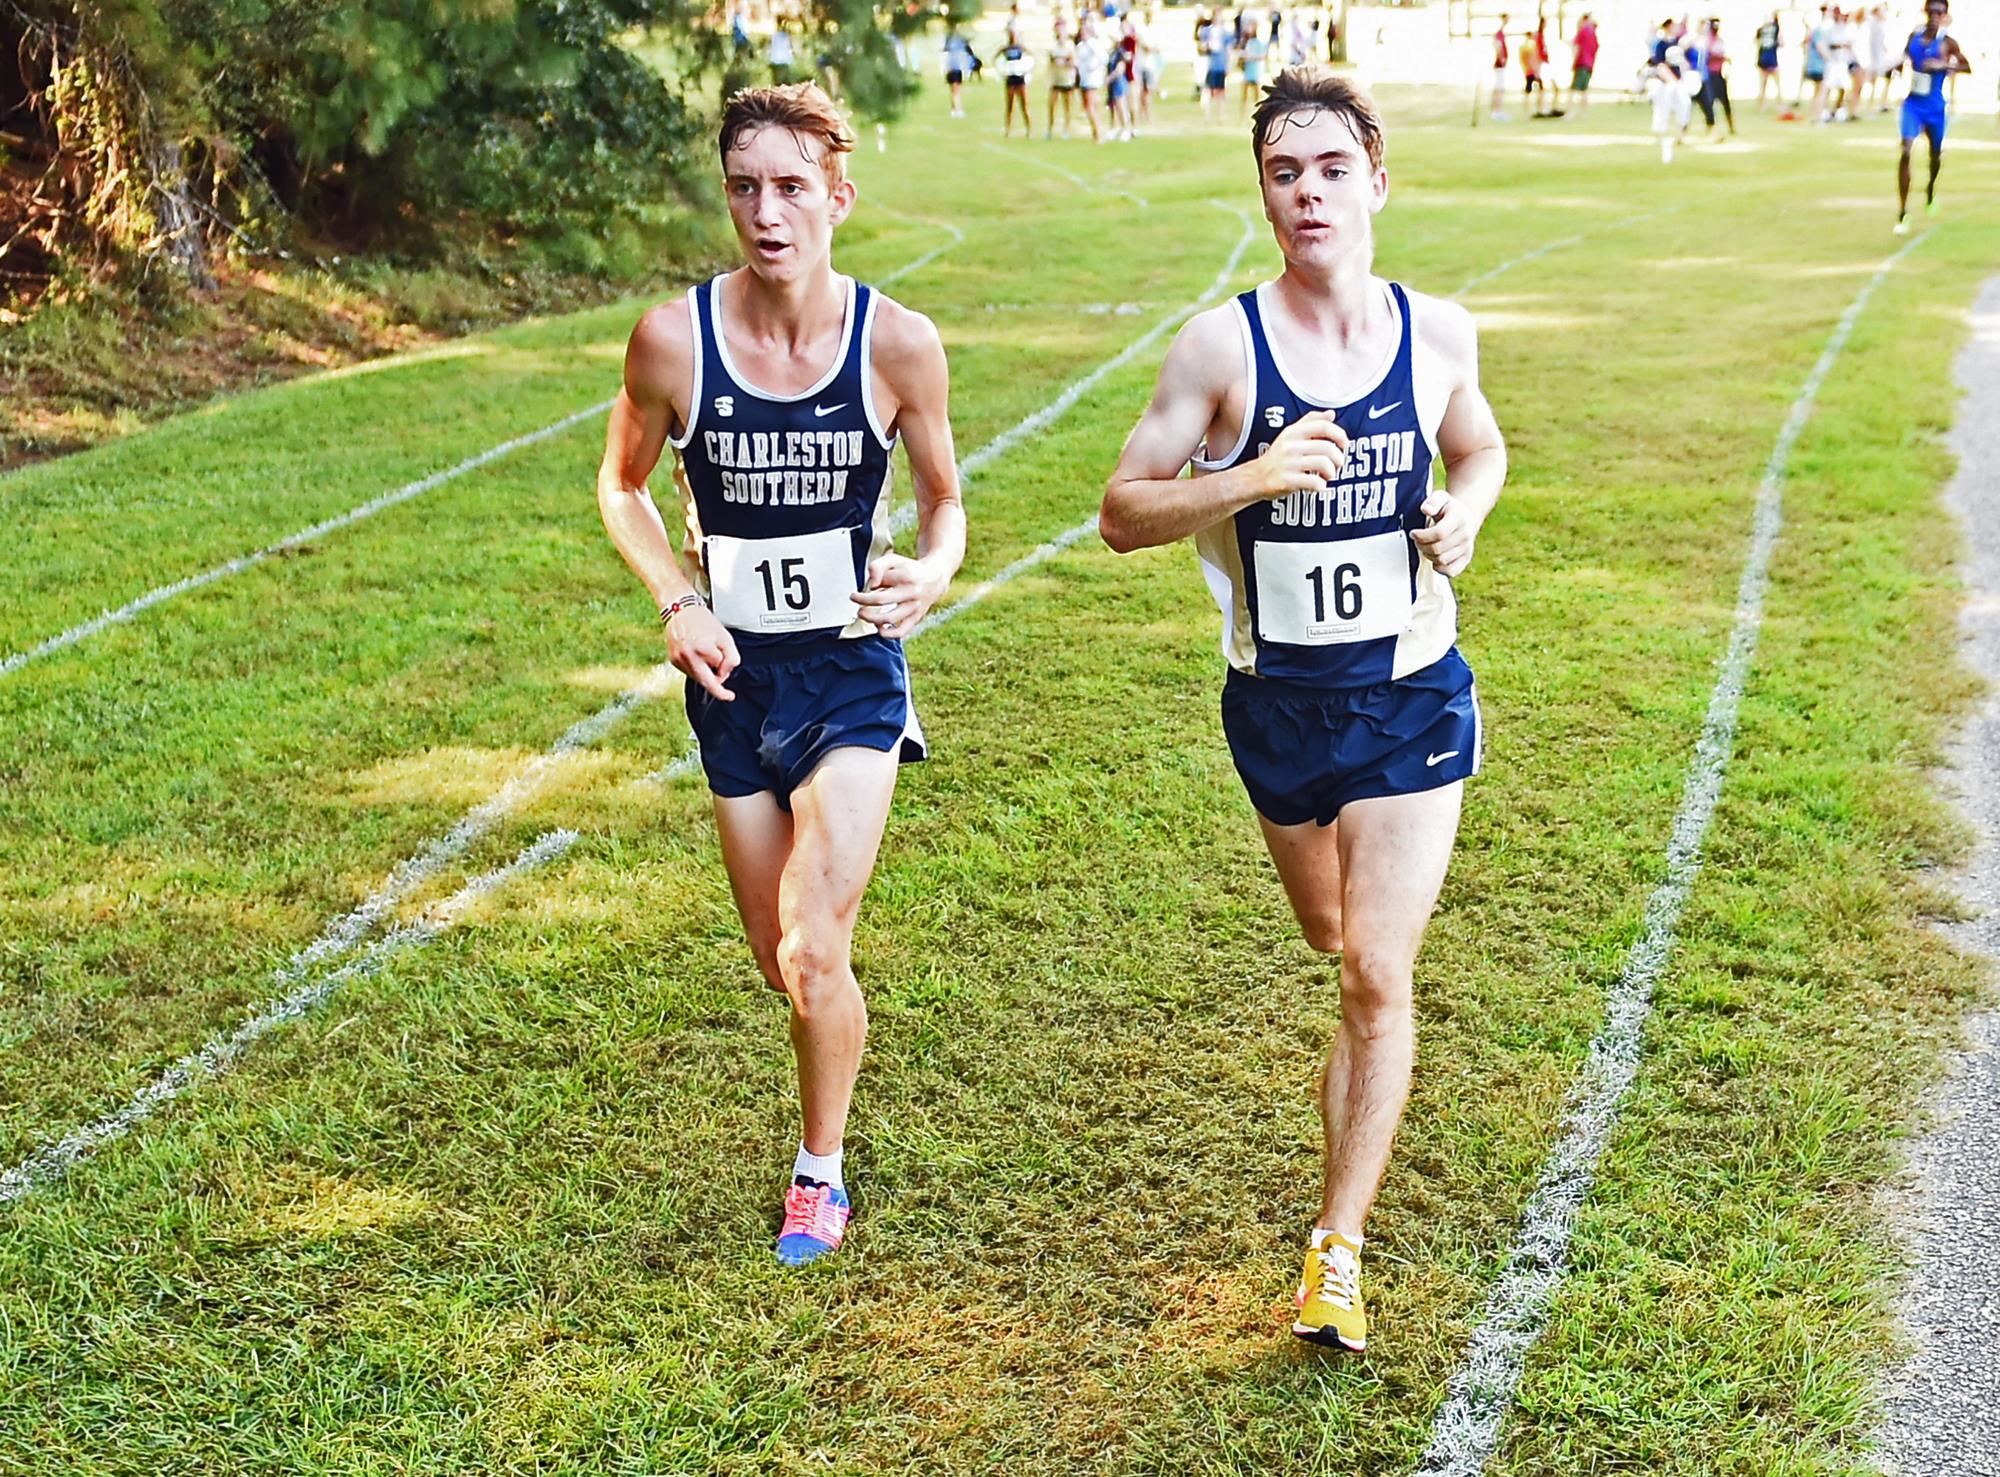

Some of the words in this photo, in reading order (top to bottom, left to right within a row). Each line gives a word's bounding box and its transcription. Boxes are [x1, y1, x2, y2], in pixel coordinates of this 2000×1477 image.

[704, 431, 863, 469] CHARLESTON
[1257, 431, 1416, 482] ESTON
[721, 470, 849, 506] SOUTHERN
[1270, 477, 1399, 527] SOUTHERN
[755, 557, 811, 611] 15
[1305, 562, 1363, 623] 16
